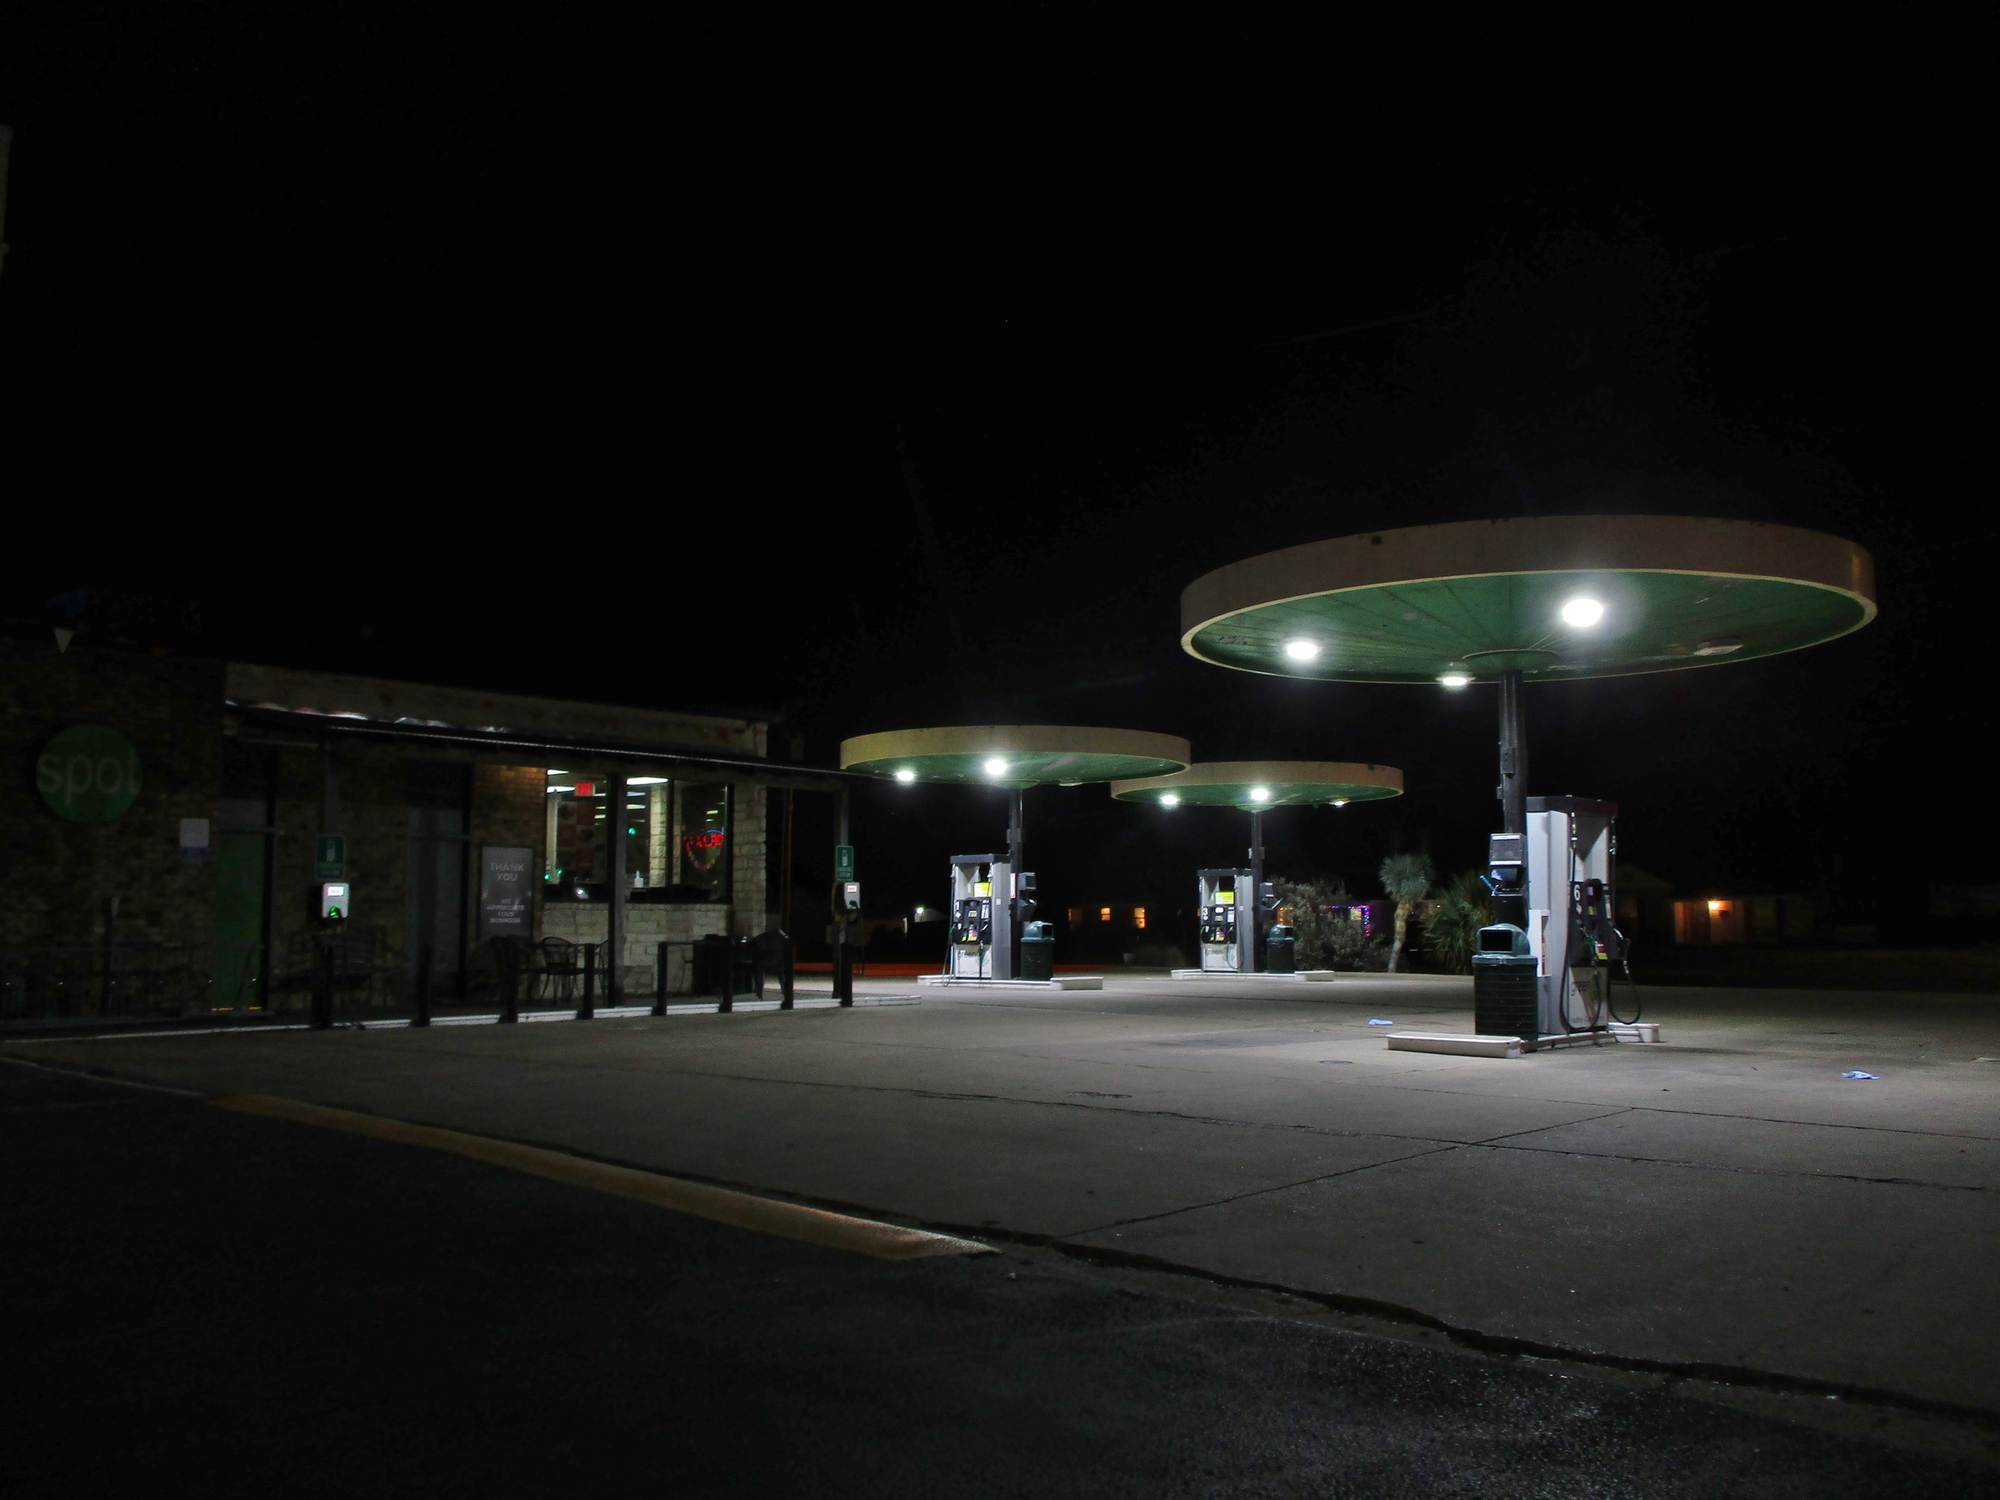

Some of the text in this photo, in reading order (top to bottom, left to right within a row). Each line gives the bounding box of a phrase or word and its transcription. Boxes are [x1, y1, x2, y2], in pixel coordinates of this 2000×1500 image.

[36, 749, 138, 805] spot
[489, 862, 525, 872] THANK
[497, 872, 518, 881] YOU
[1573, 884, 1581, 901] 6
